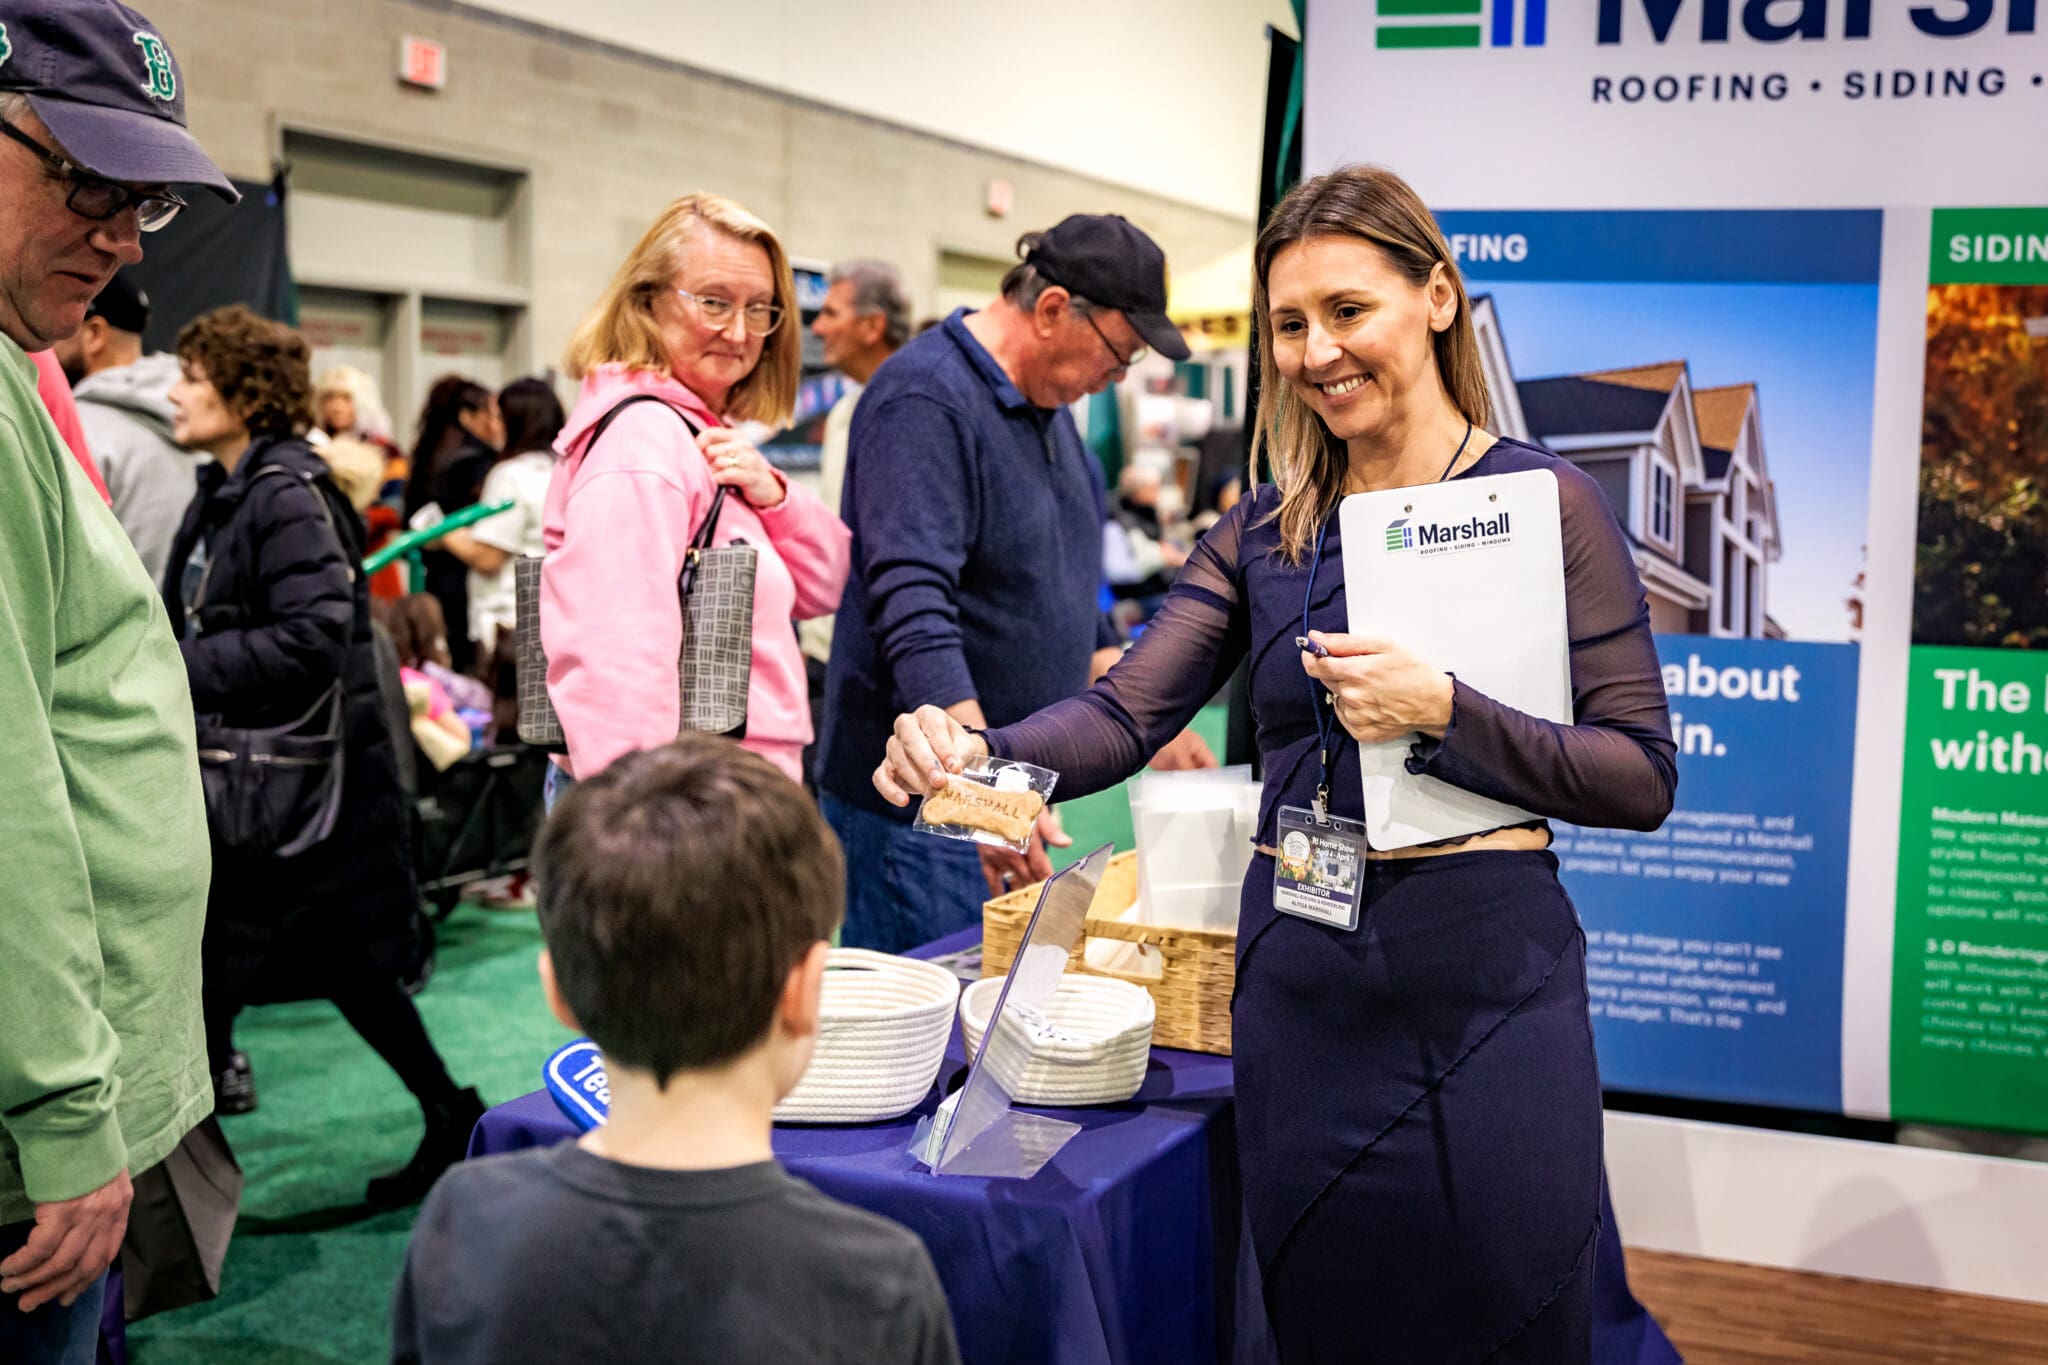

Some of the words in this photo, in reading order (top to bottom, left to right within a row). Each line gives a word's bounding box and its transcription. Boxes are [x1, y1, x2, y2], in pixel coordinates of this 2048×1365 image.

[133, 32, 176, 101] B
[1592, 73, 1788, 102] ROOFING
[1843, 68, 2007, 100] SIDING
[1443, 233, 1528, 262] FING
[1418, 512, 1510, 546] Marshall
[1420, 546, 1448, 555] ROOFING
[1454, 542, 1476, 550] SIDING
[1481, 538, 1511, 546] WINDOWS
[1662, 653, 1801, 702] about
[1933, 667, 2031, 714] The
[1930, 729, 2048, 775] with
[1319, 838, 1338, 850] Home
[1338, 842, 1356, 854] Show
[1297, 882, 1331, 898] EXHIBITOR
[1308, 903, 1332, 916] MARSHALL
